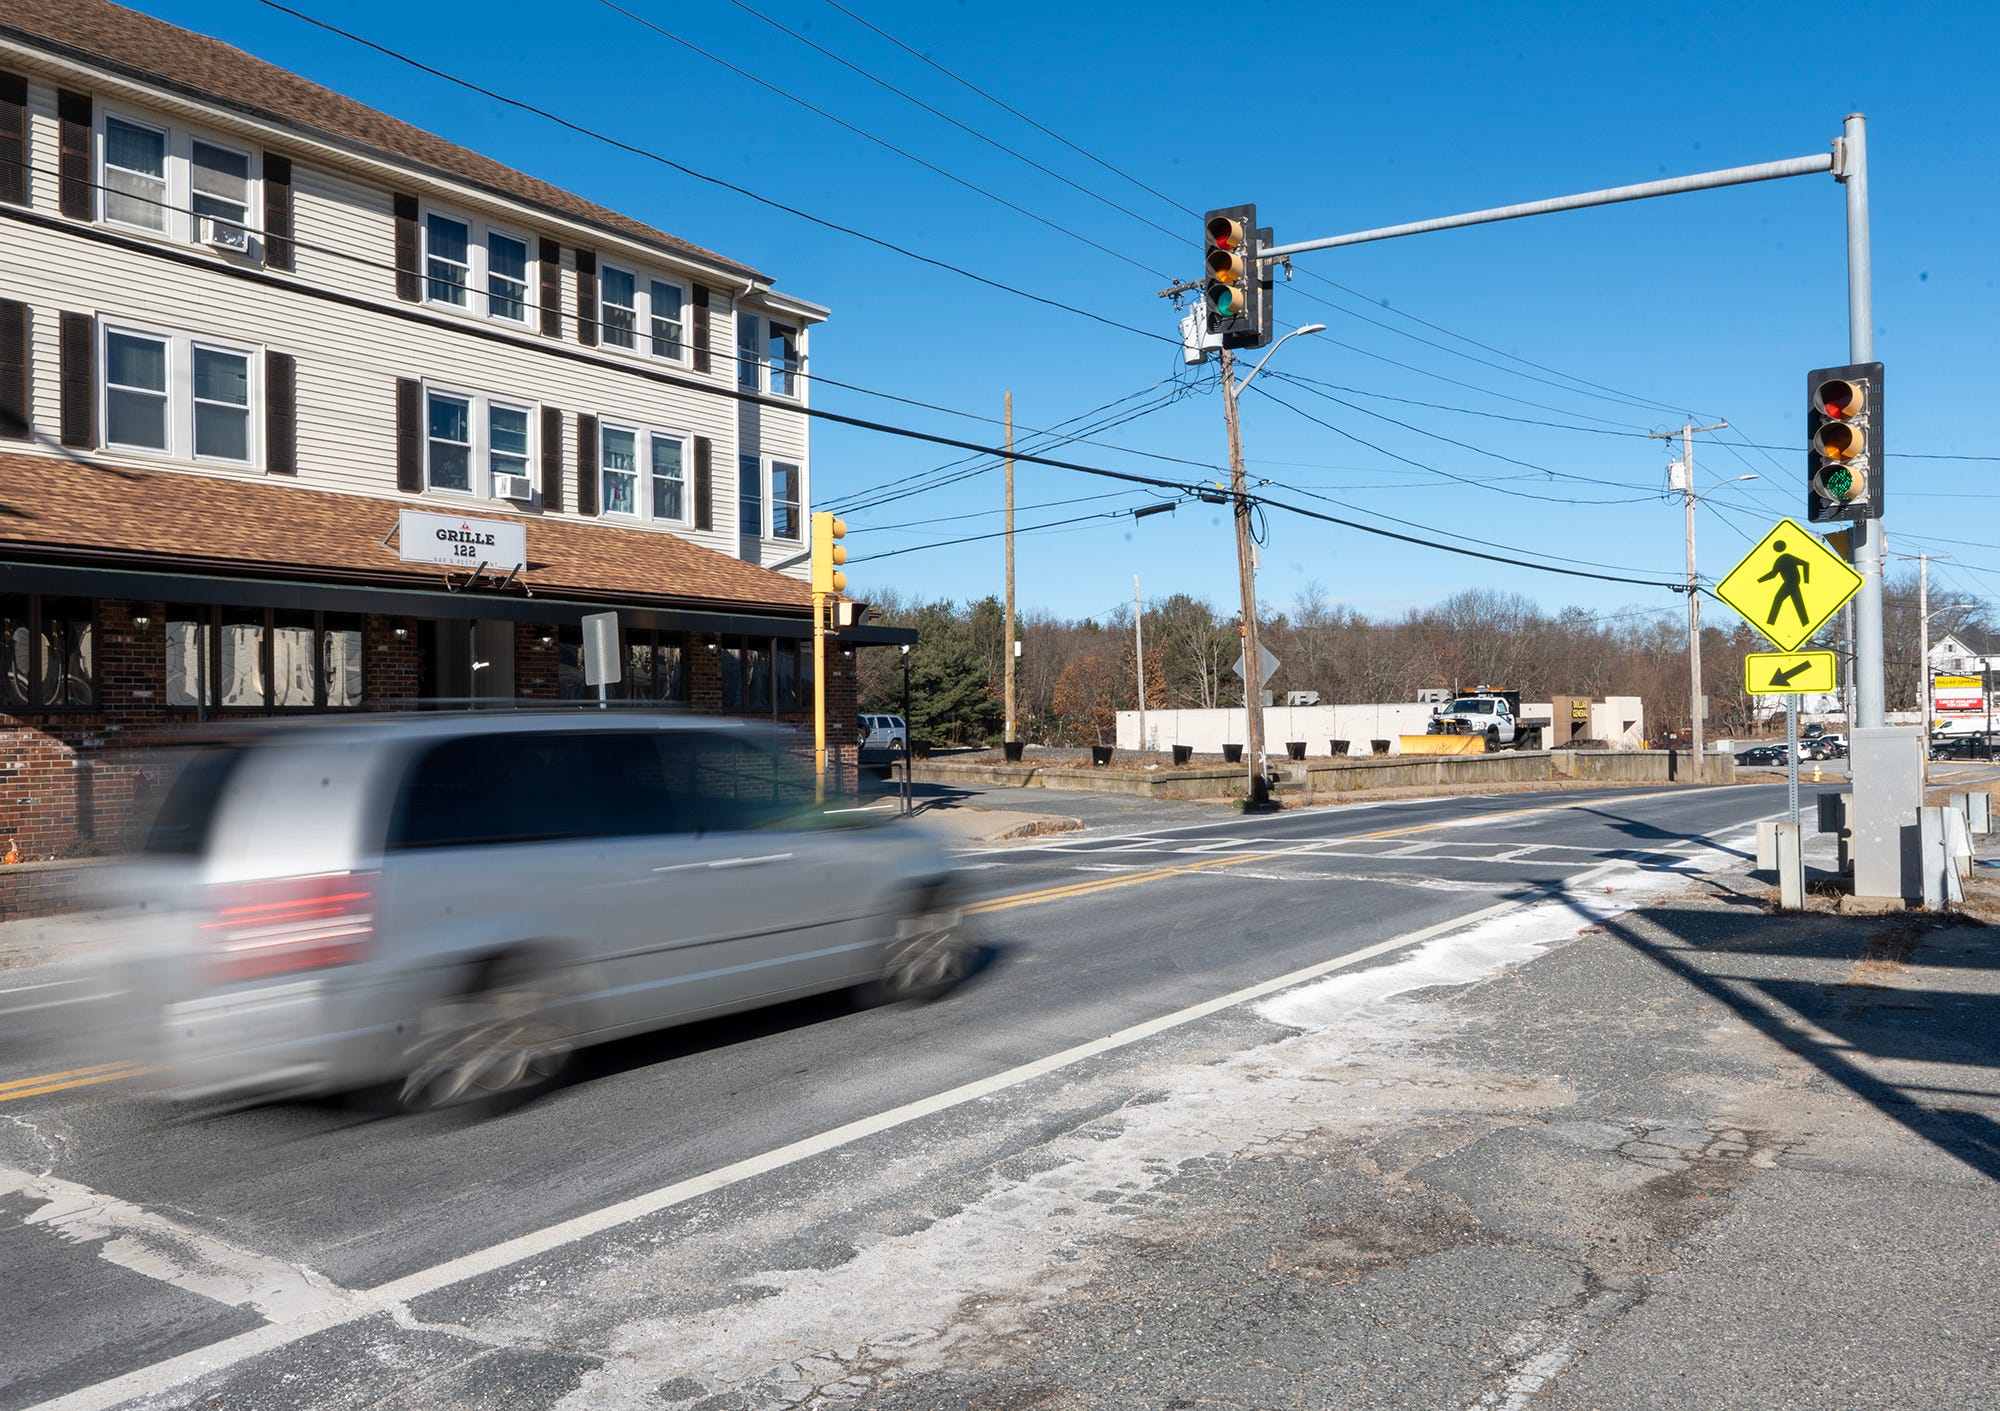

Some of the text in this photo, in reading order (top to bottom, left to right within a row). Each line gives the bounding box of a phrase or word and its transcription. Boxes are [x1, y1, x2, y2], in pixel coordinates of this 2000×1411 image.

[436, 529, 495, 546] GRILLE
[454, 545, 476, 557] 122
[457, 559, 497, 567] RESTAUANT
